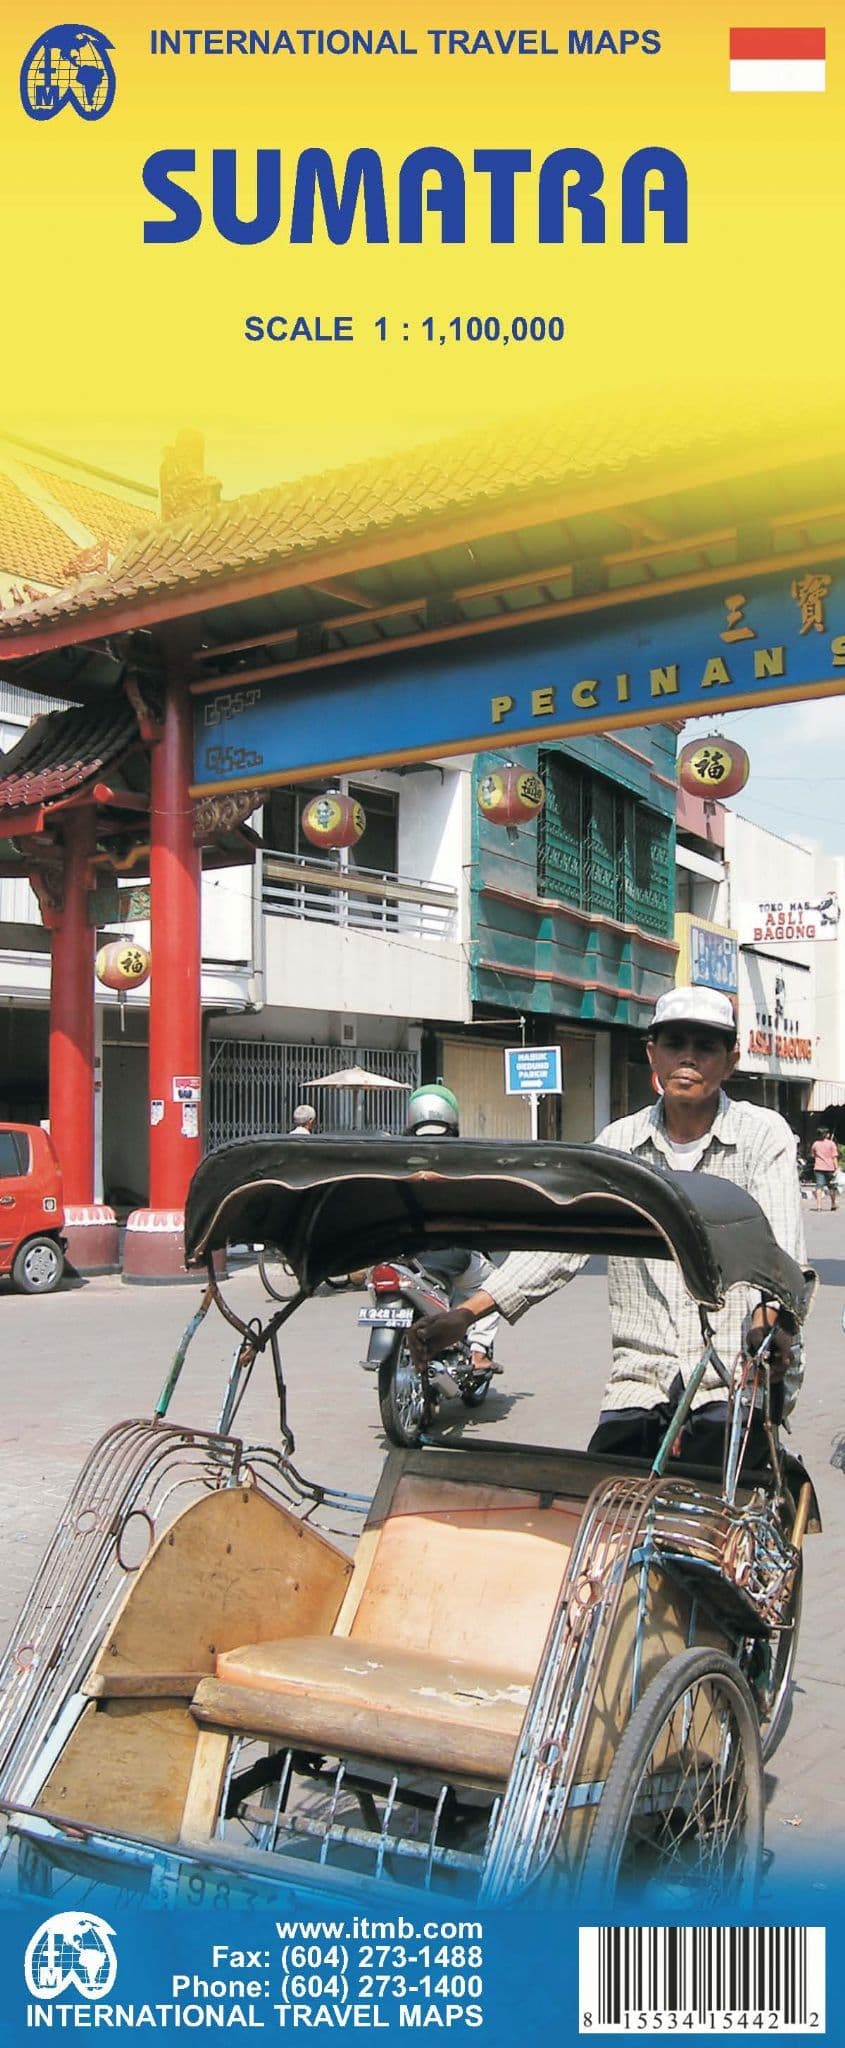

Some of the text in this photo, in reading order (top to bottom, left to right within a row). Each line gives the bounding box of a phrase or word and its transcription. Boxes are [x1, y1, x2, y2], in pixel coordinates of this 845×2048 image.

[491, 646, 785, 723] PECINAN
[766, 912, 803, 926] ASLI
[753, 925, 816, 941] BAGONG
